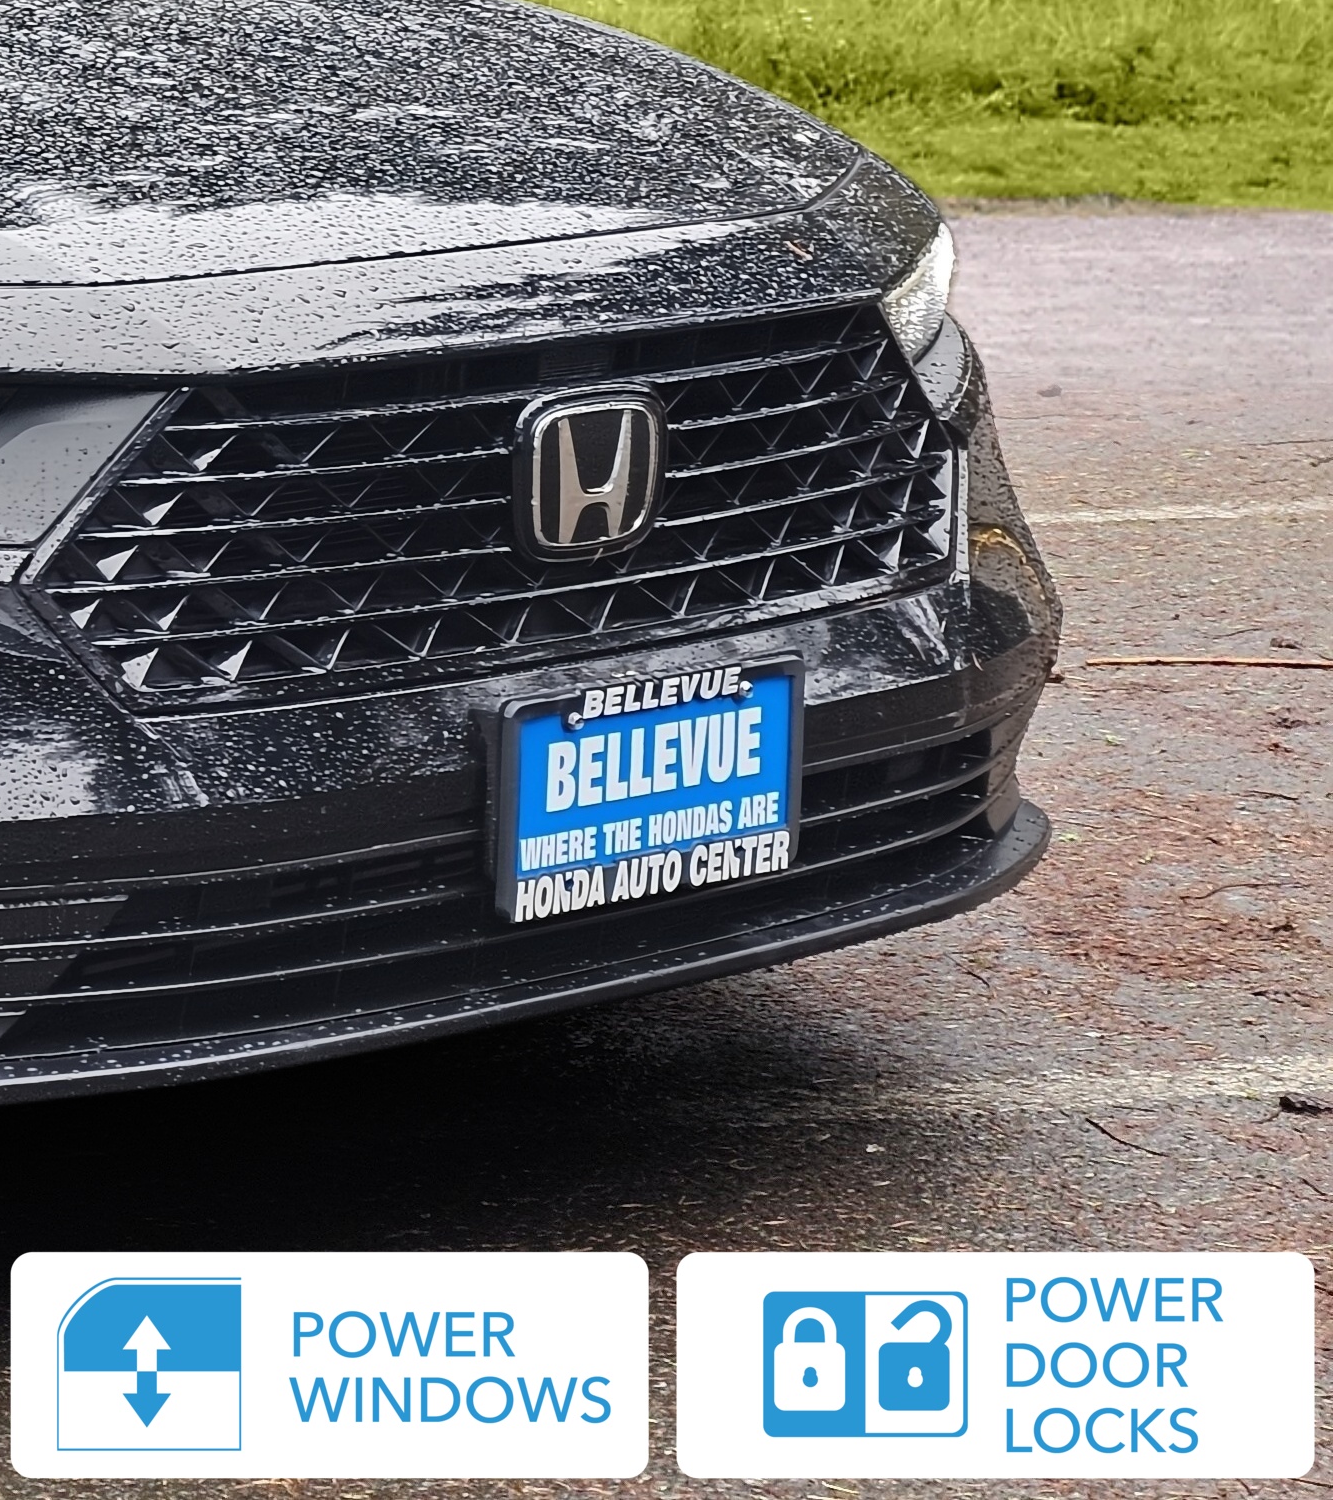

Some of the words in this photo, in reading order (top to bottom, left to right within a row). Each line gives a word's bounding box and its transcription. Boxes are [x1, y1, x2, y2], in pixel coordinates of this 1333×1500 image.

[582, 666, 743, 719] BELLEVUE
[545, 706, 763, 813] BELLEVUE
[519, 825, 598, 872] WHERE
[602, 821, 643, 856] THE
[648, 800, 733, 846] HONDAS
[737, 791, 781, 830] ARE
[513, 868, 606, 923] HONDA
[610, 849, 683, 903] AUTO
[689, 830, 791, 887] CENTER
